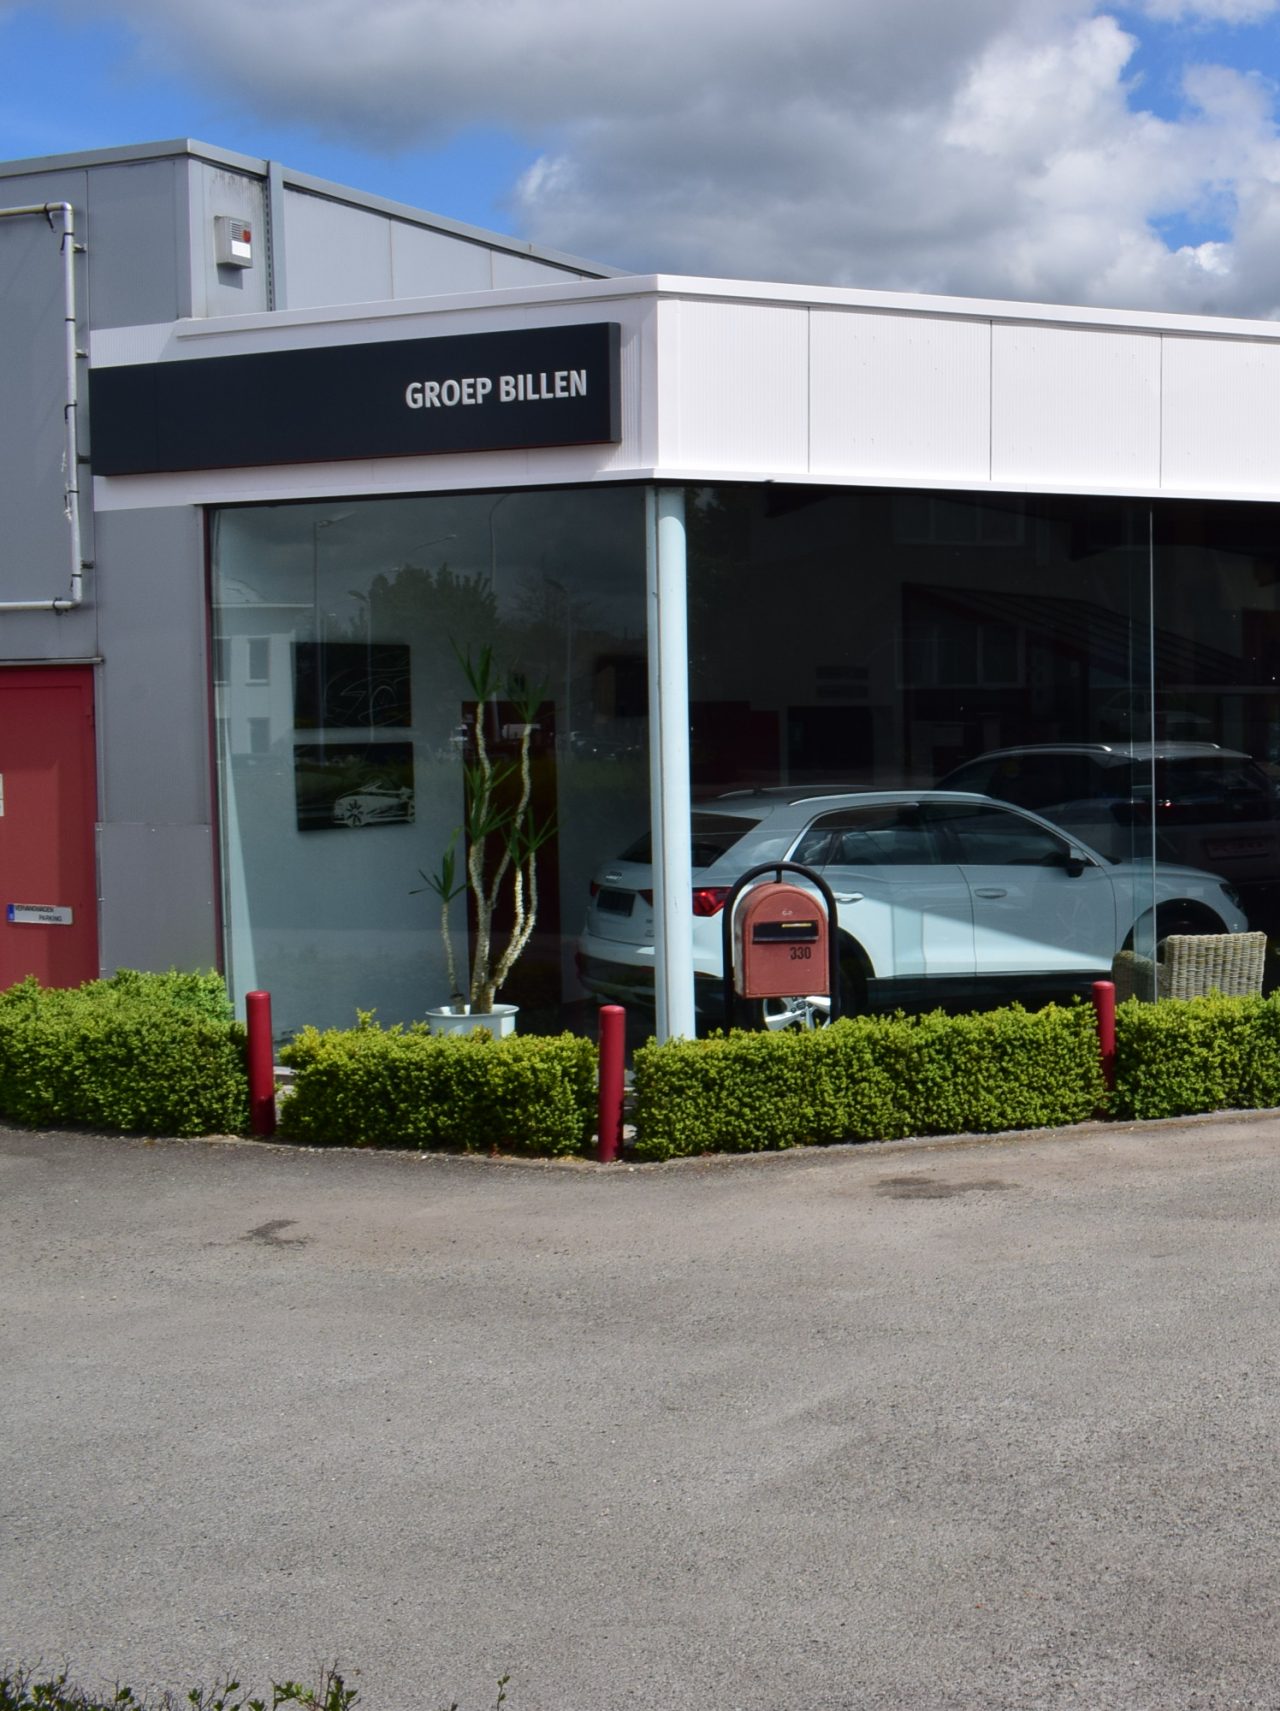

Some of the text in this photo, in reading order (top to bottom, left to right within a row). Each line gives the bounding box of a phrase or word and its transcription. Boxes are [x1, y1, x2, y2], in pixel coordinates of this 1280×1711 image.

[405, 369, 587, 409] GROEP BILLEN
[38, 914, 63, 922] PARKING
[789, 946, 812, 960] 330
